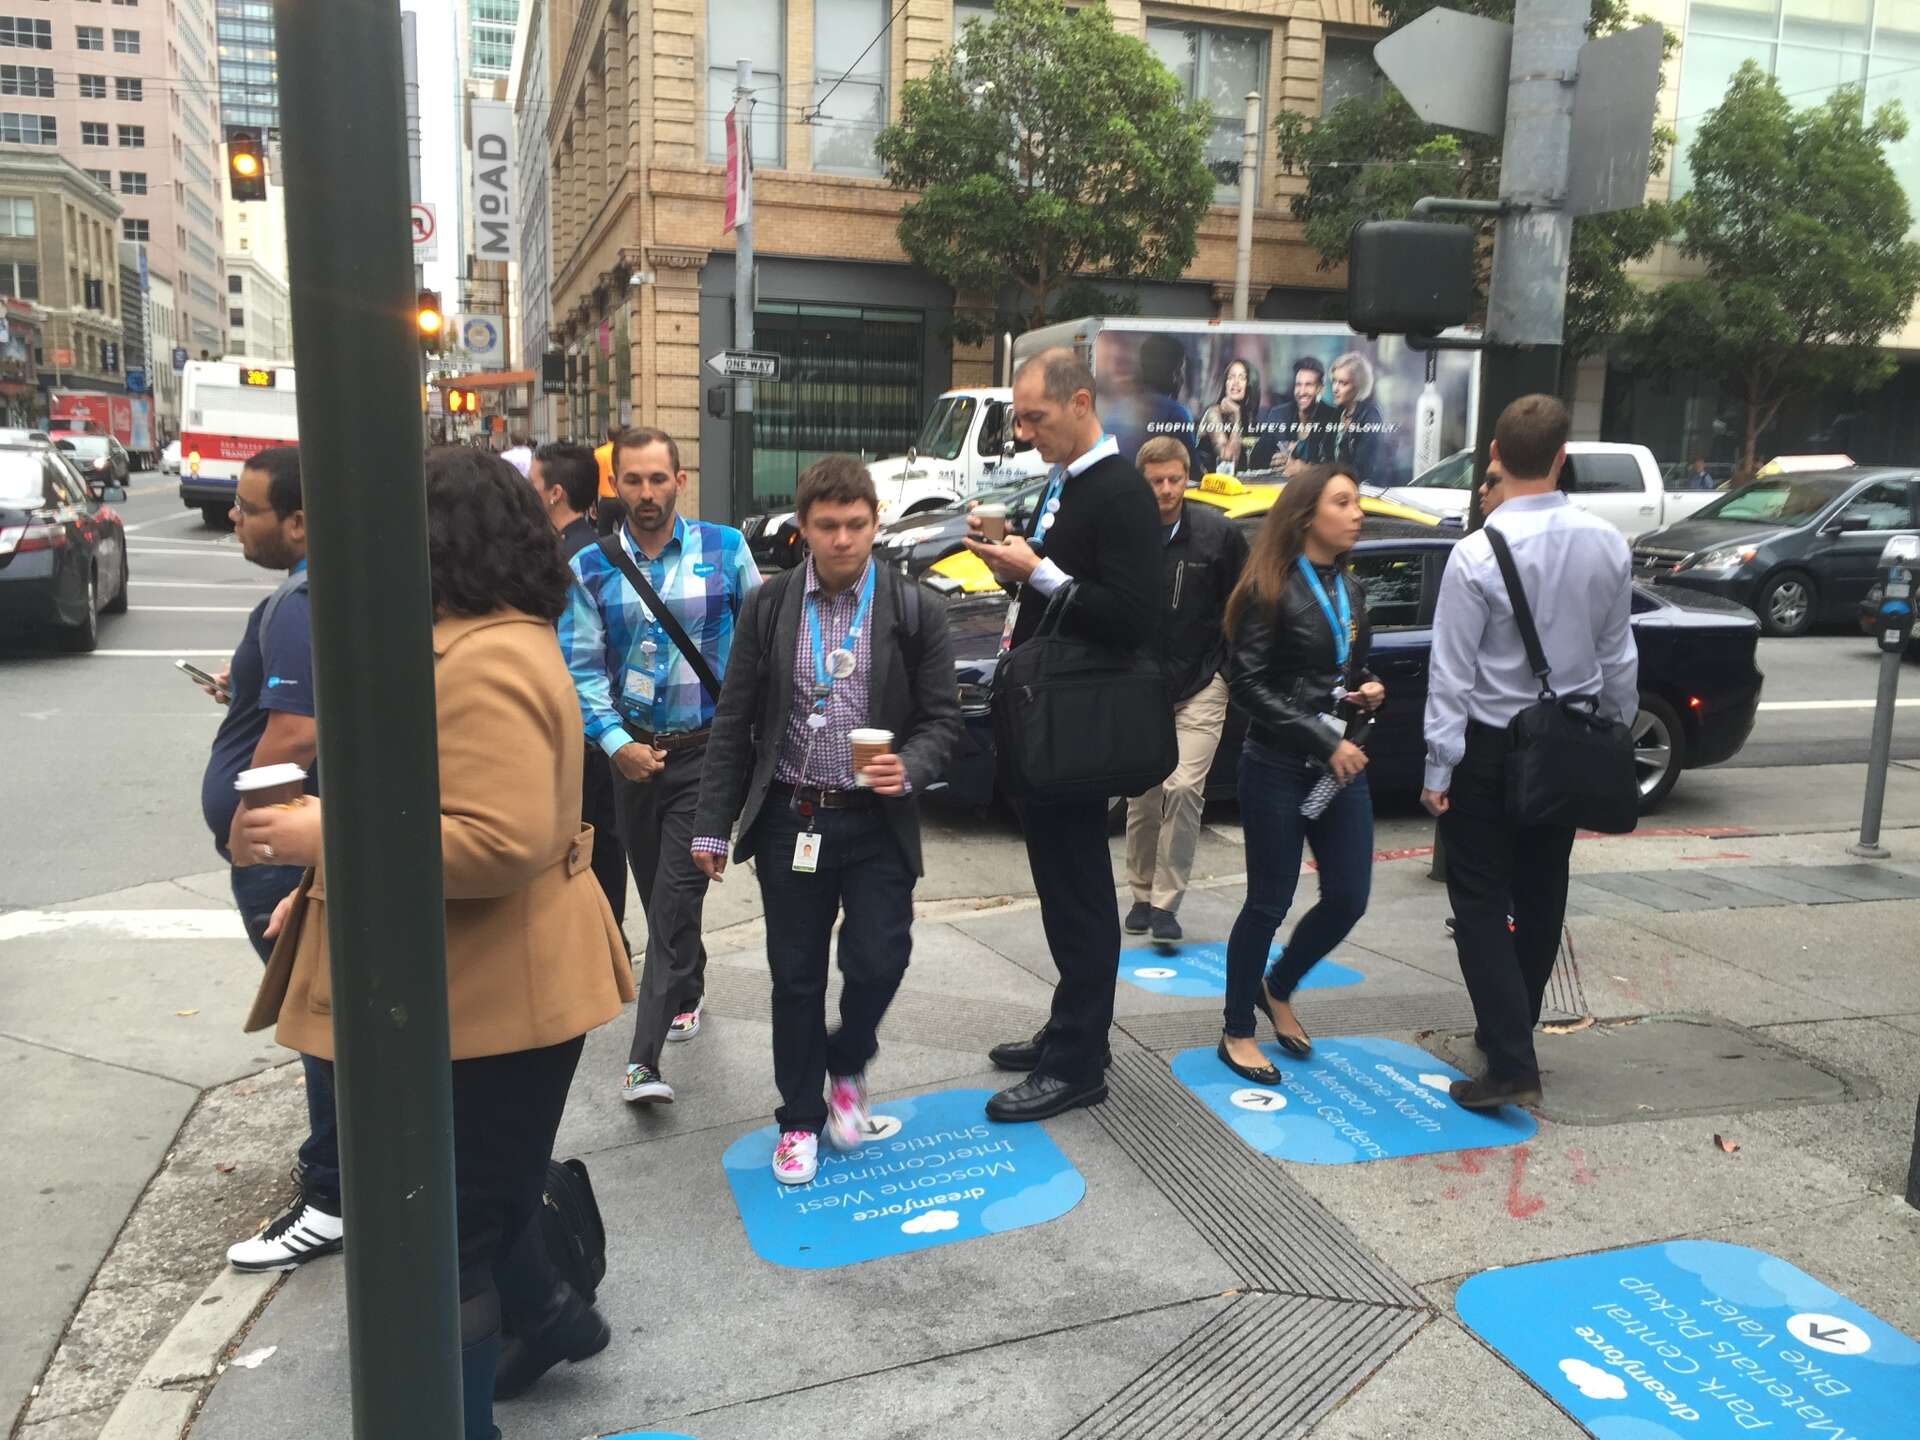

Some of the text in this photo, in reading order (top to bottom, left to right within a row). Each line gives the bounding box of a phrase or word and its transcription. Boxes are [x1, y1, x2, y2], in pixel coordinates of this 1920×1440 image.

[725, 359, 771, 371] ONE WAY
[1147, 421, 1195, 433] CHOPIN
[1247, 422, 1287, 433] LIFE'S
[1325, 422, 1345, 433] SIP
[1307, 1068, 1377, 1117] Metreon
[1320, 1050, 1442, 1133] Moscone North
[889, 1124, 991, 1153] Shuttle
[1315, 1104, 1389, 1158] Gardens
[775, 1138, 1016, 1201] InterContinental
[798, 1158, 1016, 1216] Moscone West
[852, 1186, 986, 1222] dreamforce
[1574, 1325, 1700, 1422] dreamforce
[1592, 1303, 1774, 1430] Park Central
[1619, 1276, 1858, 1440] Materials Pickup
[1700, 1296, 1853, 1398] Bike Valet
